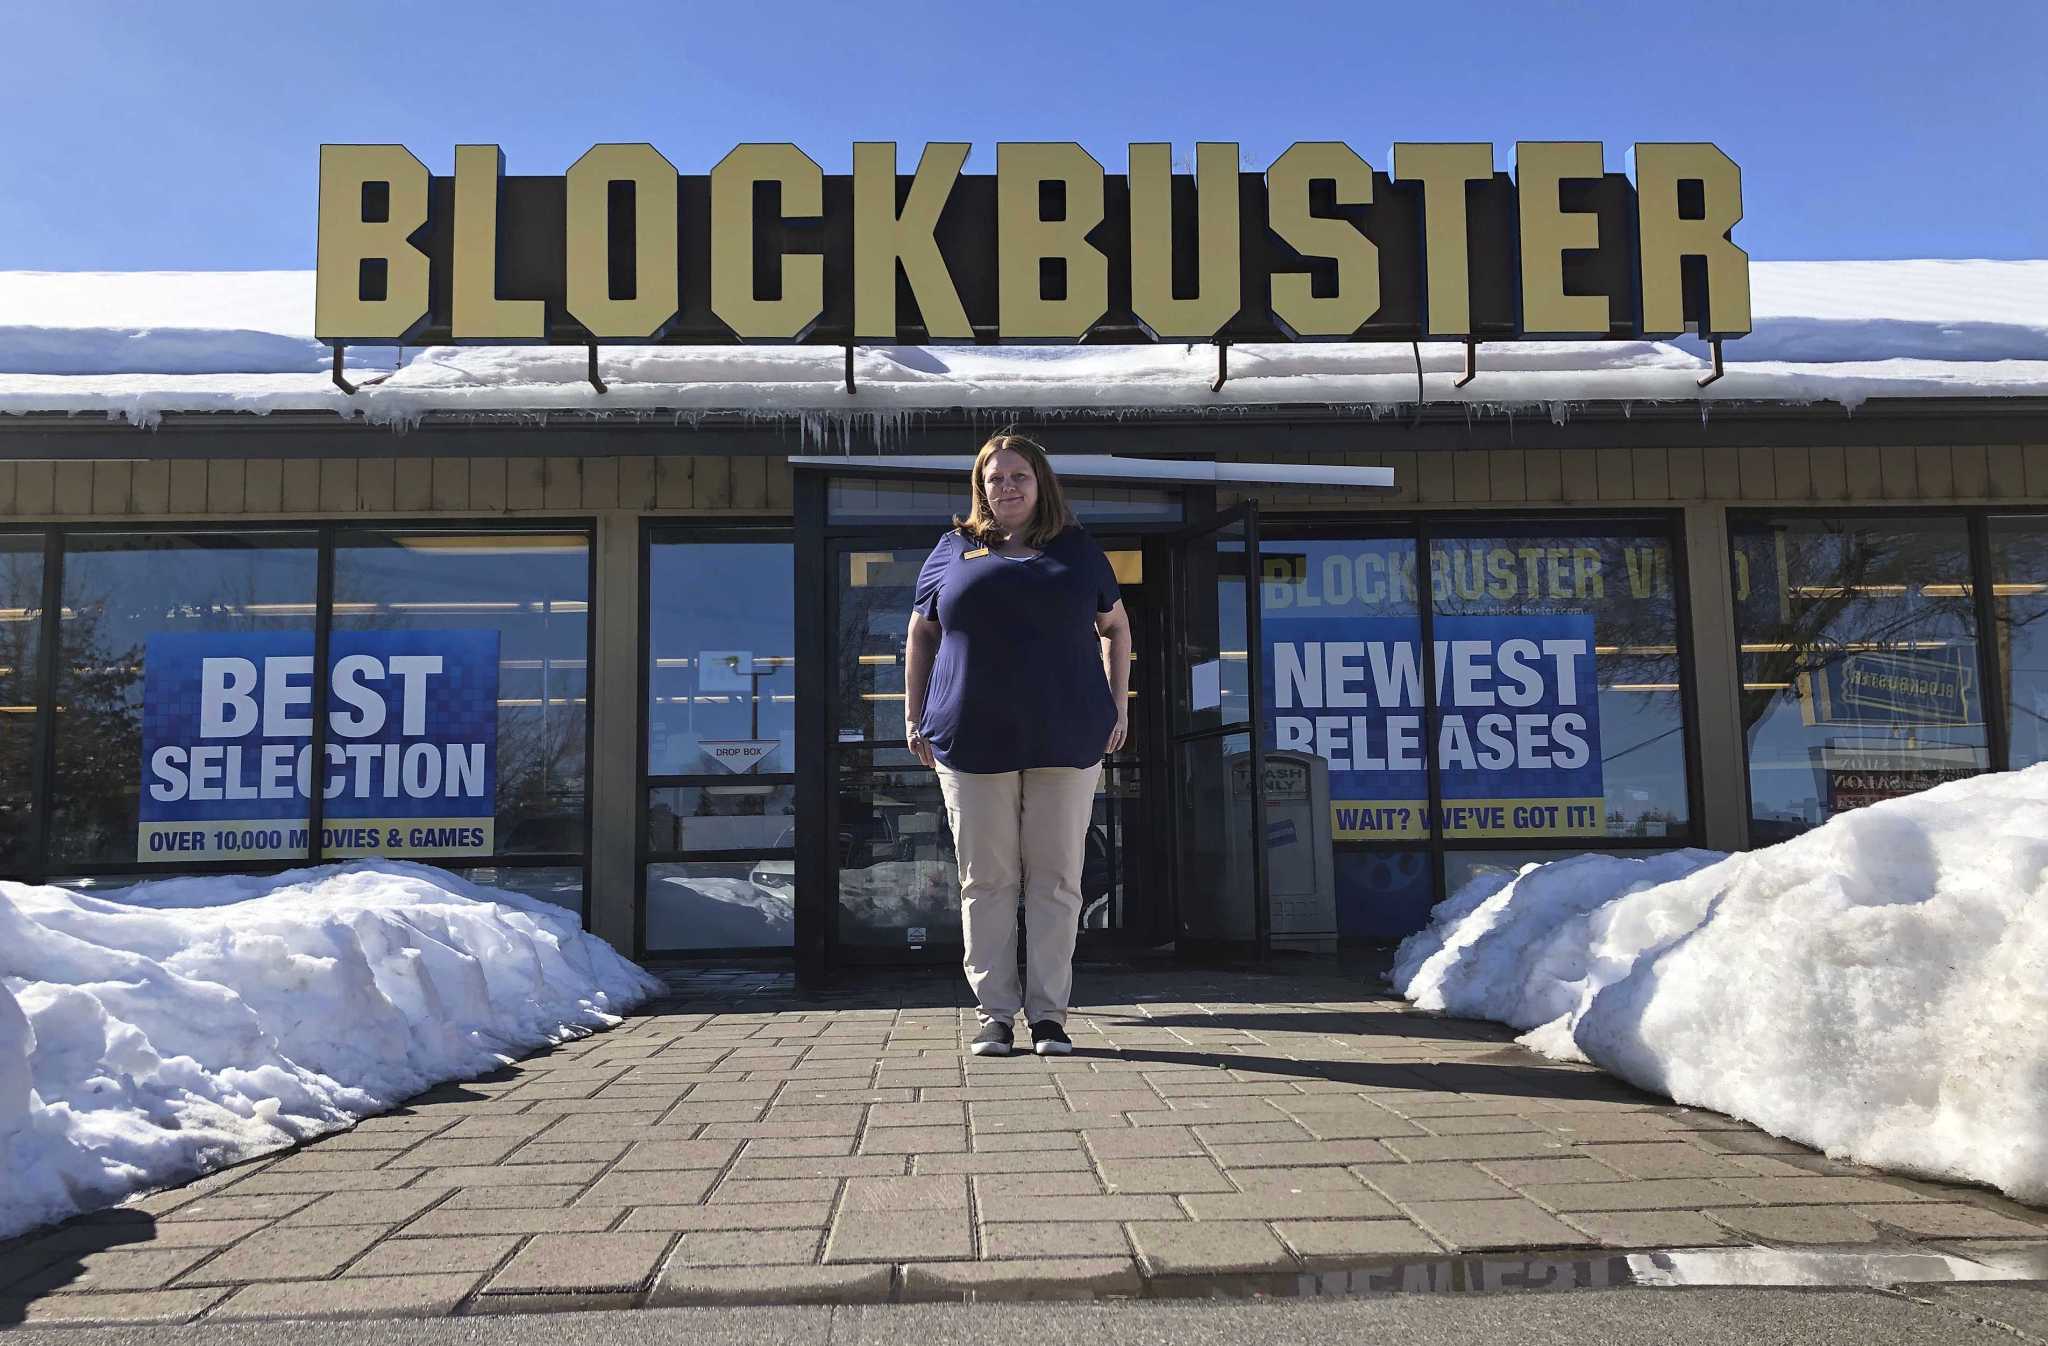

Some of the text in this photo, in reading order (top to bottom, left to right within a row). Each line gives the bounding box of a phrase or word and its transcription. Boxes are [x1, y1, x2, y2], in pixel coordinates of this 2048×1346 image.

[315, 141, 1752, 340] BLOCKBUSTER
[1263, 548, 1605, 609] BLOCKBUSTER
[200, 654, 443, 738] BEST
[1273, 639, 1587, 708] NEWEST
[716, 747, 763, 757] DROP BOX
[1275, 713, 1590, 770] RELEASES
[150, 743, 486, 801] SELECTION
[1232, 768, 1303, 780] TASH
[150, 827, 485, 853] OVER 10,000 MOVIES & GAMES
[1336, 805, 1597, 831] WAIT? WE'VE GOT IT!
